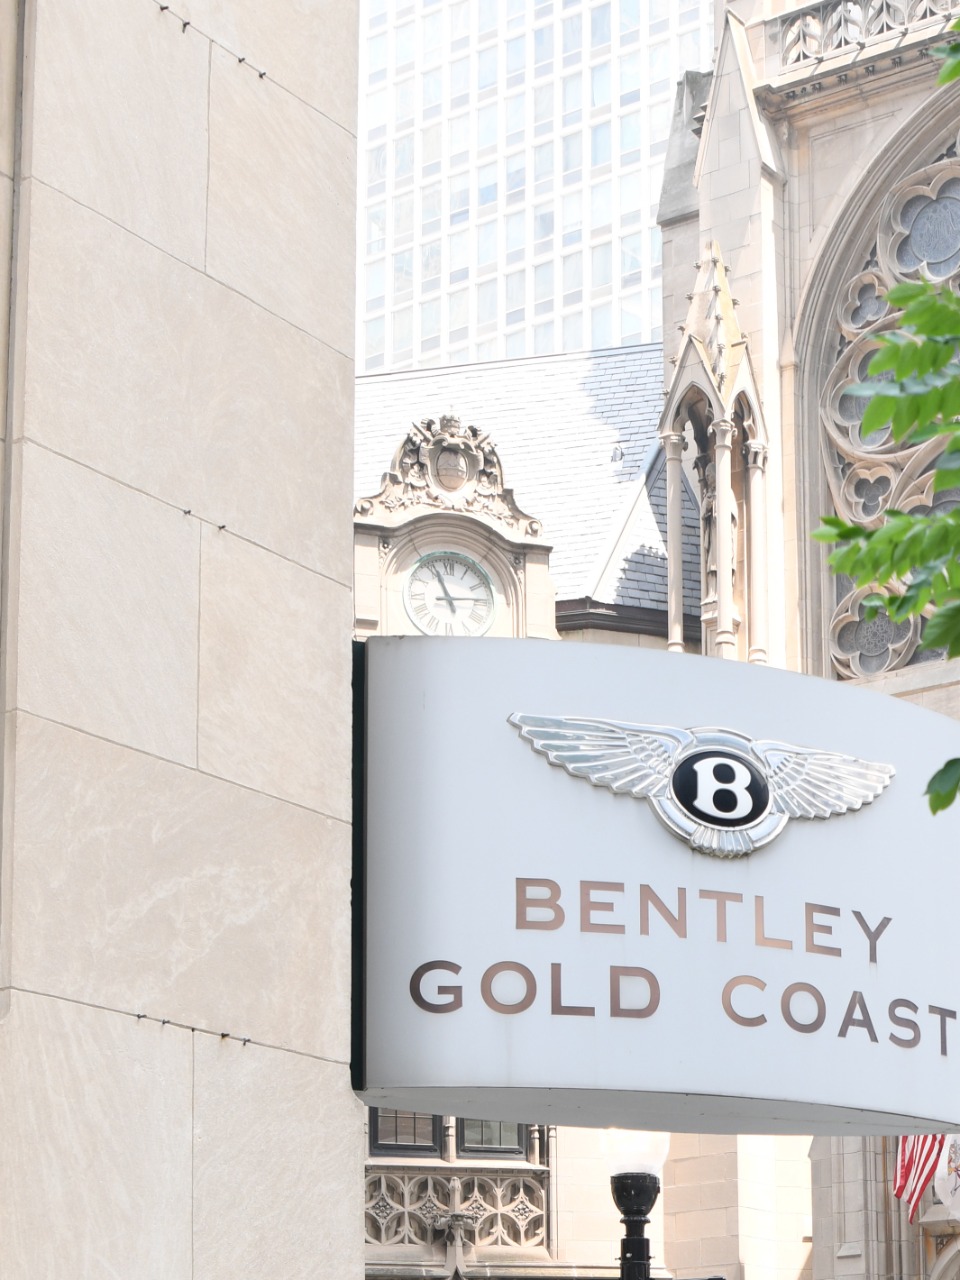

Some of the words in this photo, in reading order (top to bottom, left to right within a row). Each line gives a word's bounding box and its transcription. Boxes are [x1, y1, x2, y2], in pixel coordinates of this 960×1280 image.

[692, 757, 754, 820] B
[515, 876, 893, 964] BENTLEY
[409, 959, 661, 1019] GOLD
[721, 974, 957, 1057] COAST
